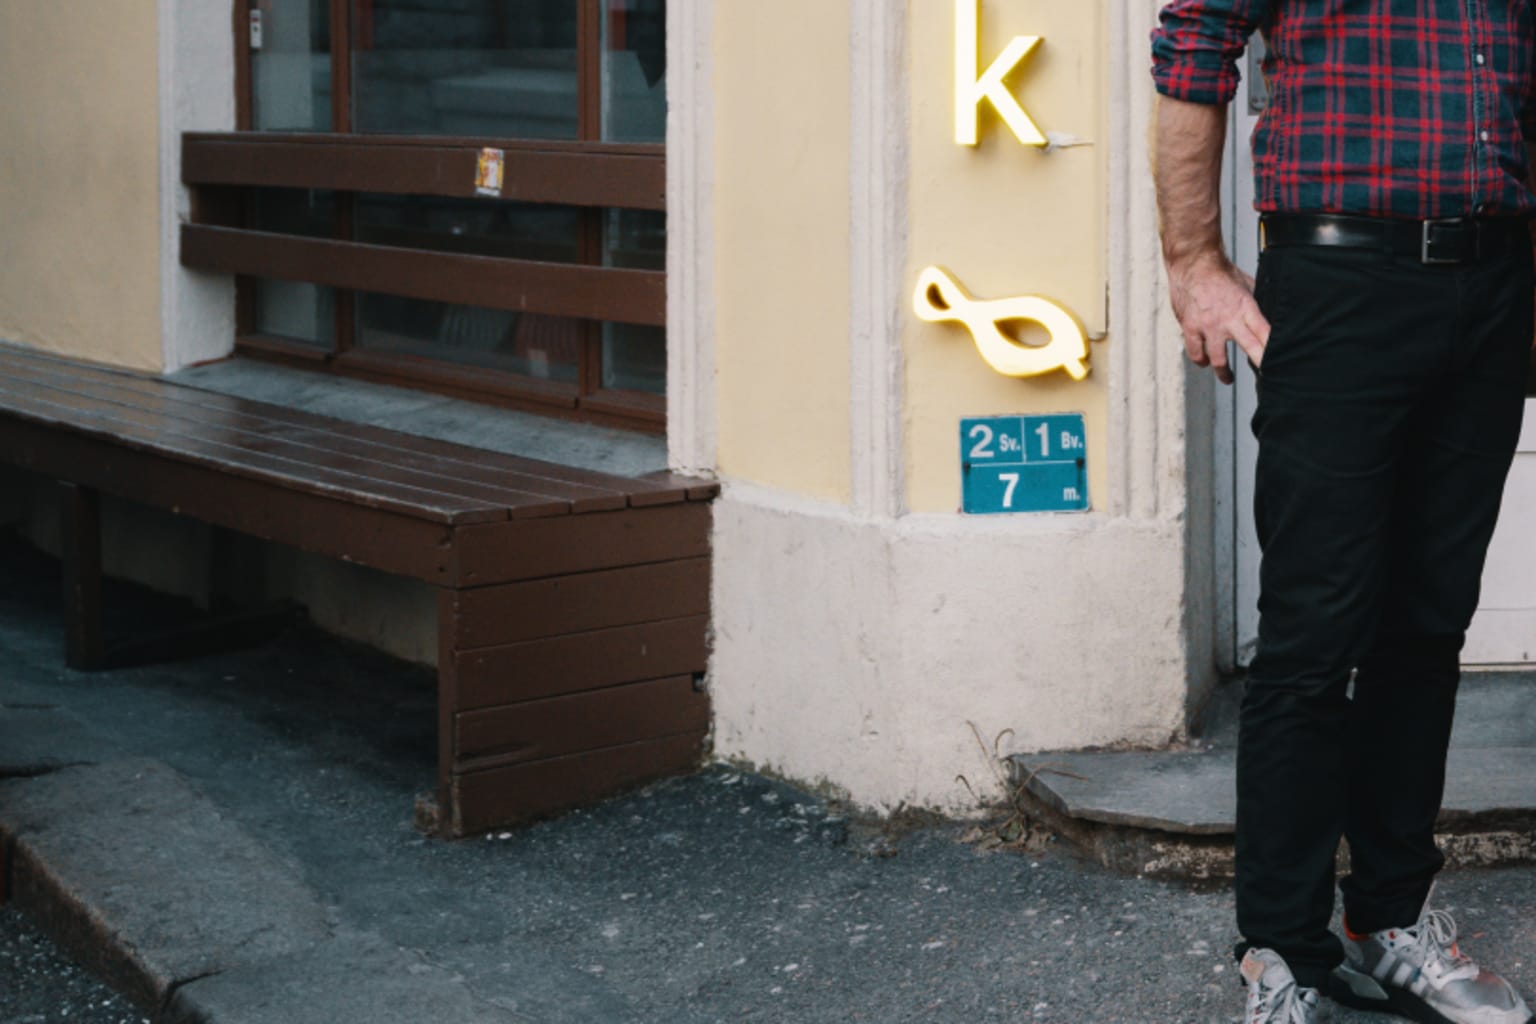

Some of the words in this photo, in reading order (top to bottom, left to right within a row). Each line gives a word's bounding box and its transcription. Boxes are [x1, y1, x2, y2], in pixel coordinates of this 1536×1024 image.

[968, 423, 995, 458] 2
[999, 433, 1021, 452] Sv.
[1035, 422, 1050, 456] 1
[1061, 431, 1084, 449] Bv.
[998, 473, 1019, 508] 7
